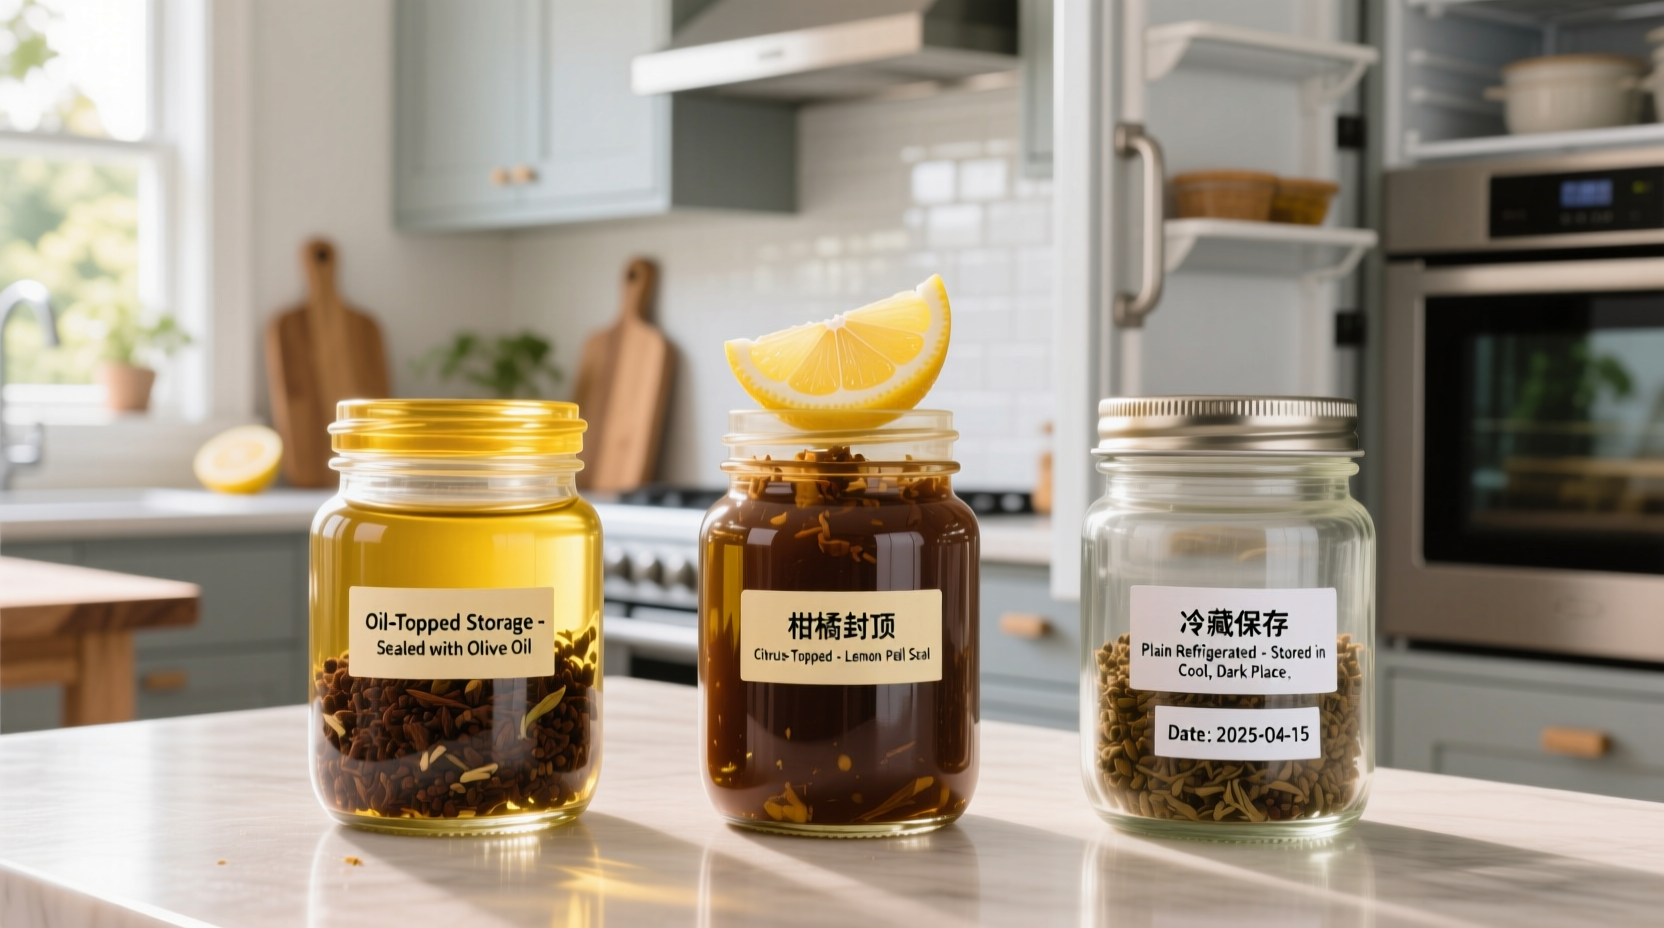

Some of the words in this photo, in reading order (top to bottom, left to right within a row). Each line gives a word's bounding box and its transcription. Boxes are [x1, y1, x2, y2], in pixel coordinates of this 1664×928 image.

[365, 611, 461, 637] Oil-Topped
[466, 613, 534, 636] Storage
[787, 610, 896, 641] 柑橘封顶
[1179, 607, 1289, 638] 冷藏保存
[376, 639, 426, 657] Sealed
[429, 640, 464, 657] with
[466, 639, 508, 657] Olive
[510, 637, 532, 655] Oil
[1141, 642, 1172, 658] Plain
[1175, 643, 1257, 663] Refrigerated
[1270, 644, 1312, 660] Stored
[1314, 644, 1326, 659] in
[1178, 662, 1213, 681] Cool,
[1216, 663, 1248, 680] Dark
[1167, 723, 1212, 744] Date:
[1216, 725, 1310, 744] 2025-04-15
